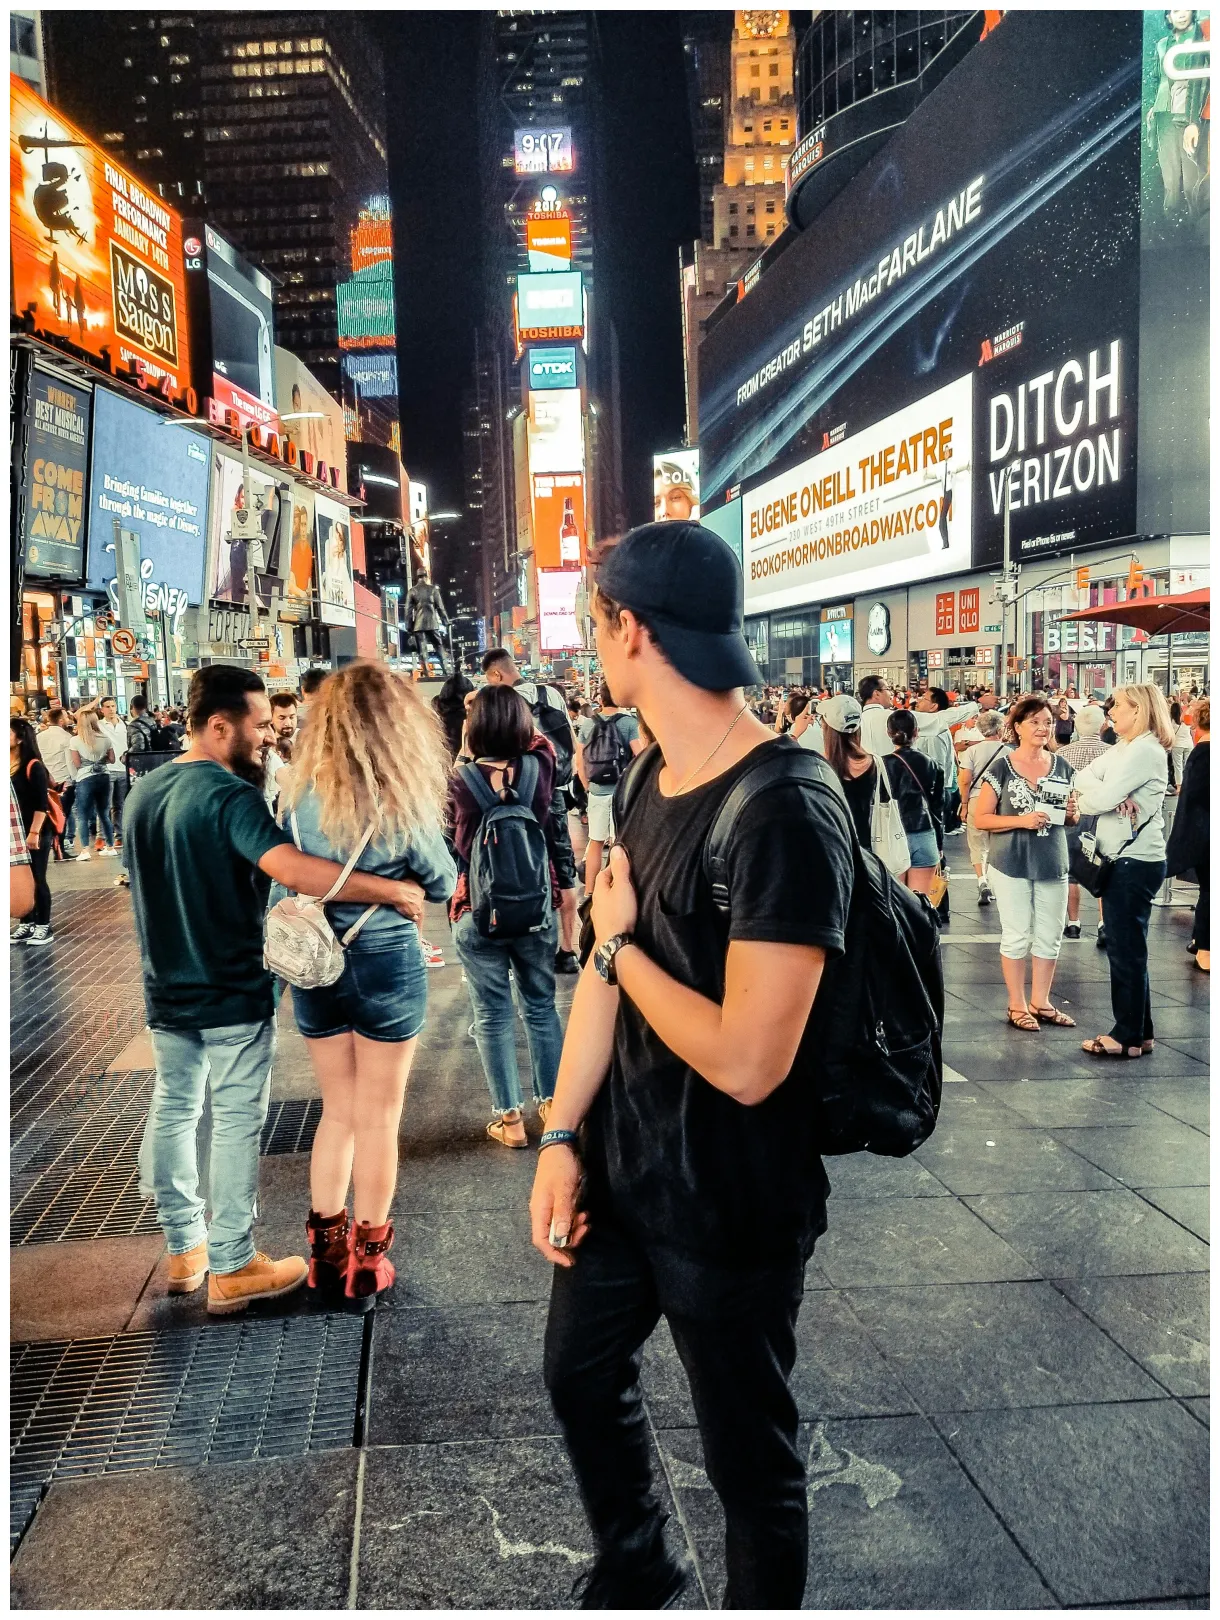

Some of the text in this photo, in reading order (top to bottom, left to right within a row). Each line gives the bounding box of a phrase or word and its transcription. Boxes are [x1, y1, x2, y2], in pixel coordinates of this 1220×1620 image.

[522, 133, 563, 154] 9:07
[104, 162, 170, 232] FINAL BROADWAY
[528, 211, 568, 220] TOSHIBA
[112, 190, 167, 250] PERFORMANCE
[114, 215, 169, 271] JANUARY 14TH
[186, 258, 201, 269] LG
[118, 290, 175, 356] Saigon
[520, 326, 583, 339] TOSHIBA
[994, 320, 1025, 344] MARRIOTT
[736, 374, 760, 406] FROM
[760, 339, 800, 388] CREATOR
[803, 294, 842, 353] SETH
[994, 334, 1021, 356] MARQUIS
[542, 362, 573, 374] TDK
[36, 399, 84, 436] BEST MUSICAL
[232, 390, 242, 407] The
[990, 339, 1120, 463] DITCH
[204, 397, 340, 488] BROADWAY
[33, 458, 83, 496] COME
[751, 417, 953, 540] EUGENE O'NEILL THEATRE
[989, 428, 1120, 516] VERIZON
[32, 482, 82, 520] FROM
[104, 473, 198, 517] Bringing families together
[30, 511, 81, 544] AWAY
[99, 493, 201, 538] through the magic of Disney.
[789, 498, 881, 542] 230 WEST 49TH STREET
[961, 594, 976, 610] UNI
[961, 612, 977, 630] QLO
[1048, 626, 1112, 651] BEST
